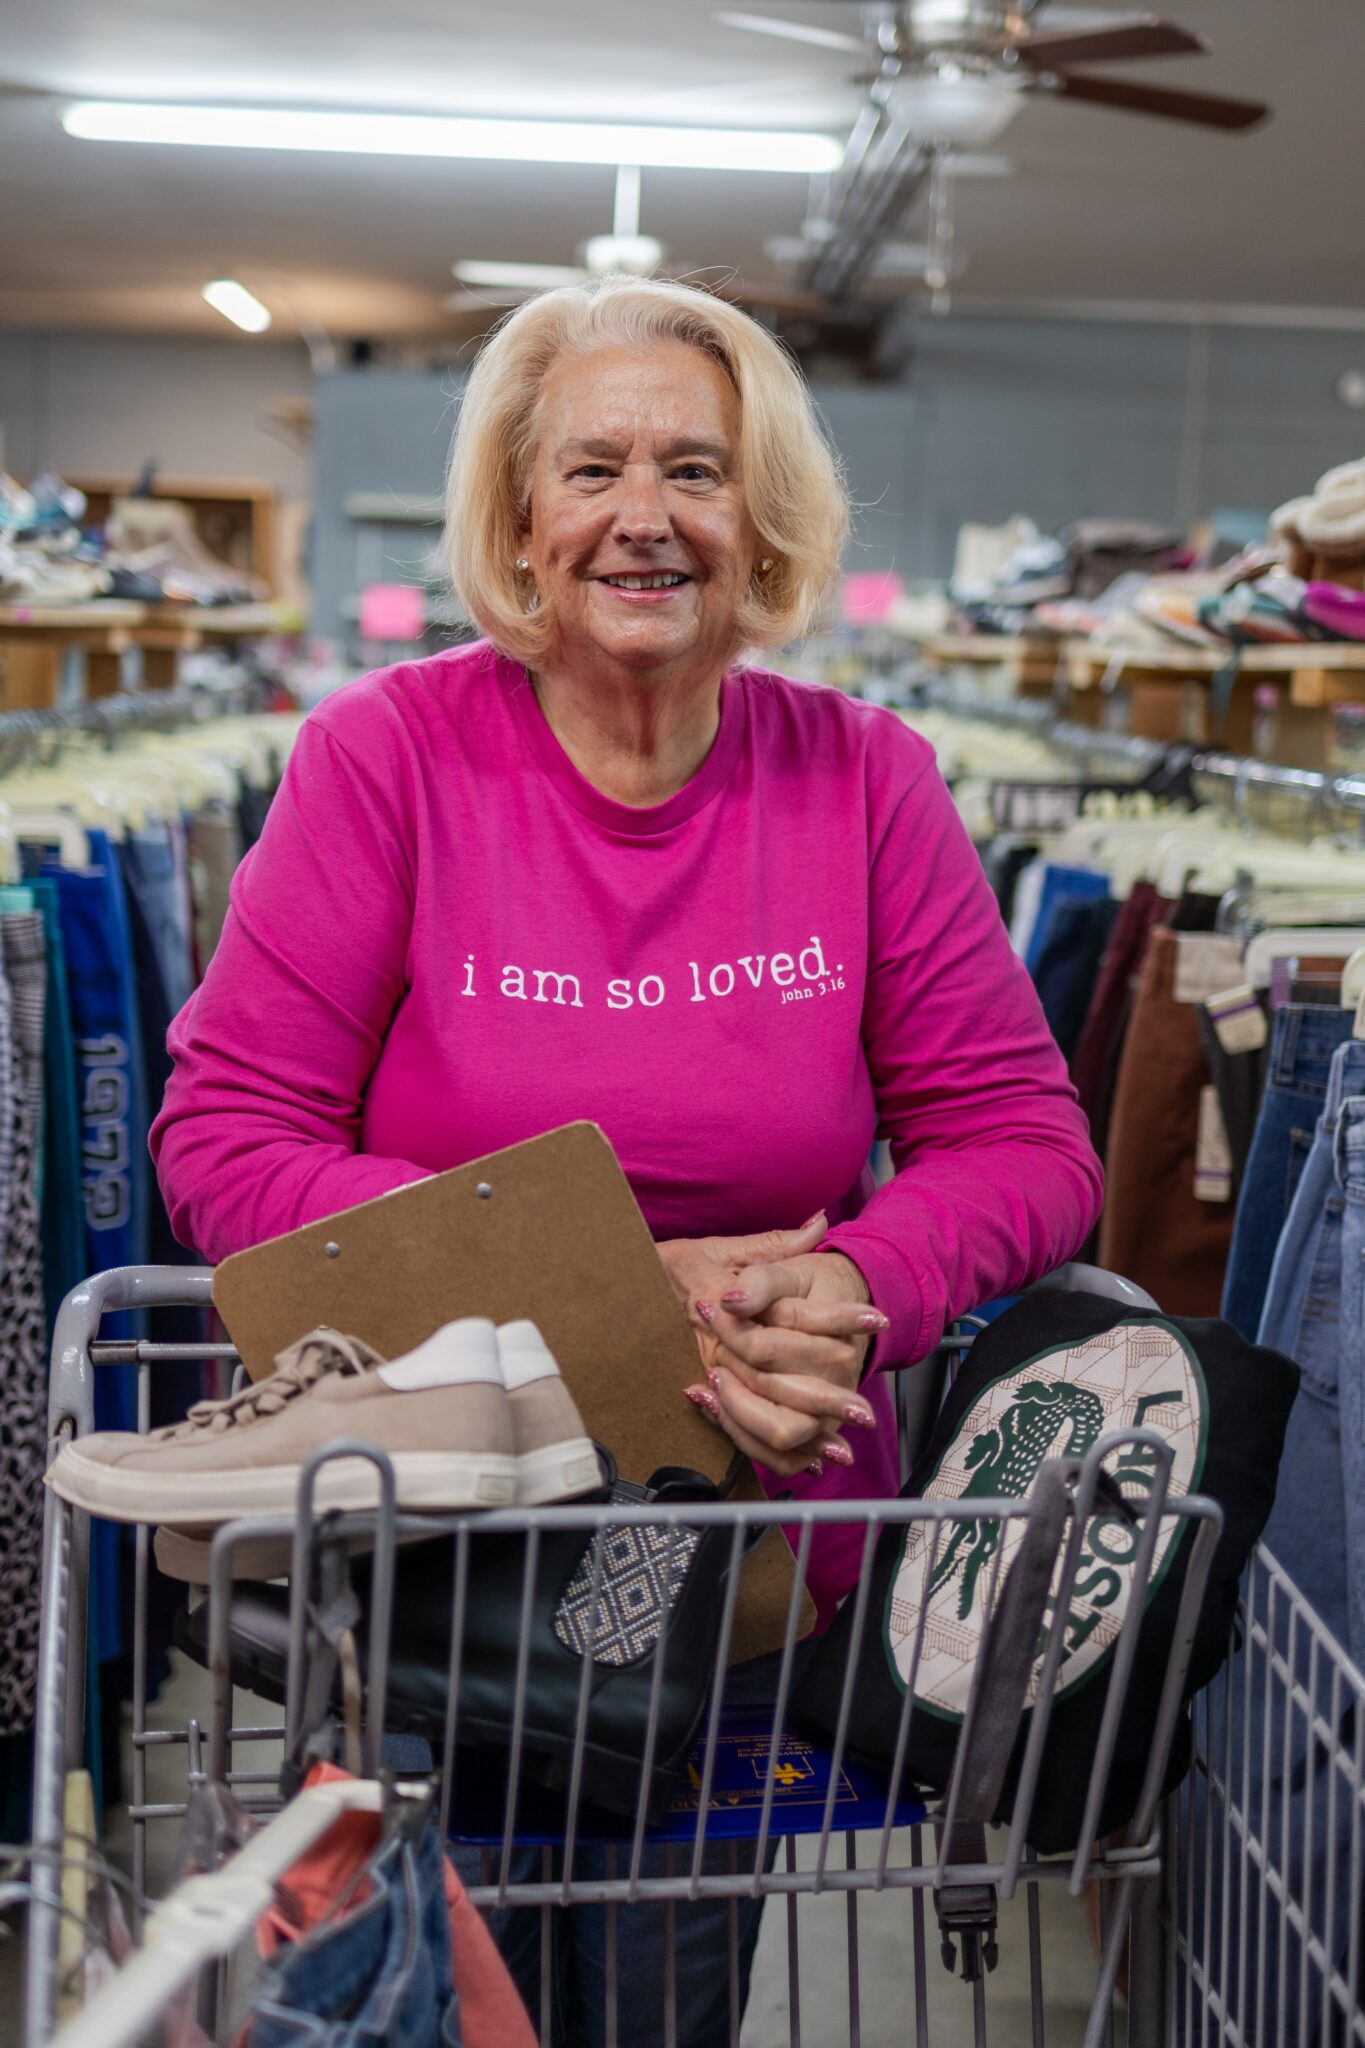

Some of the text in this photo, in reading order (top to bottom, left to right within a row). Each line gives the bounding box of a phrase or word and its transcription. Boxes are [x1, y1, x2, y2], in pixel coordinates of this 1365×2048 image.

[461, 936, 844, 1010] i am so loved.
[780, 976, 846, 1005] john 3.16
